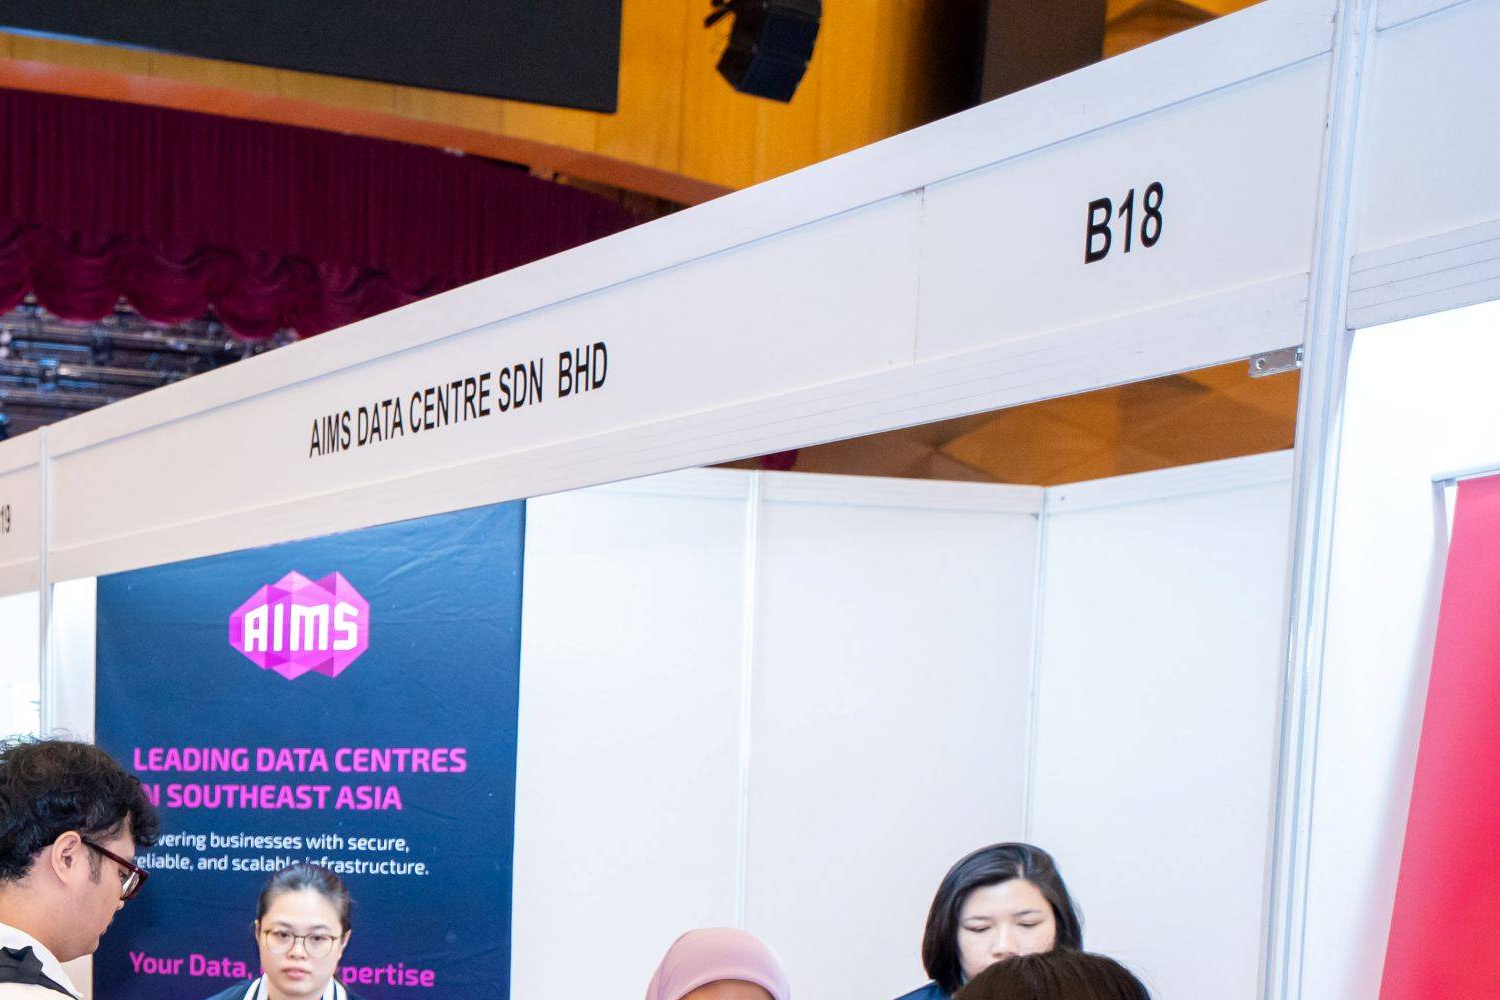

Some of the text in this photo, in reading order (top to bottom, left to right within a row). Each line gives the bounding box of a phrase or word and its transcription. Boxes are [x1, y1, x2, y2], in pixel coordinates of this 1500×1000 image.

[1084, 181, 1164, 265] B18
[309, 341, 608, 458] AIMS DATA CENTRE SDN BHD
[244, 601, 359, 652] AIMS
[133, 747, 468, 773] LEADING DATA CENTRES
[166, 784, 332, 810] SOUTHEAST
[334, 785, 403, 811] ASIA
[210, 831, 303, 850] businesses
[305, 833, 344, 850] with
[347, 837, 410, 853] secure,
[197, 854, 229, 871] and
[129, 951, 435, 988] Your Data, pertise
